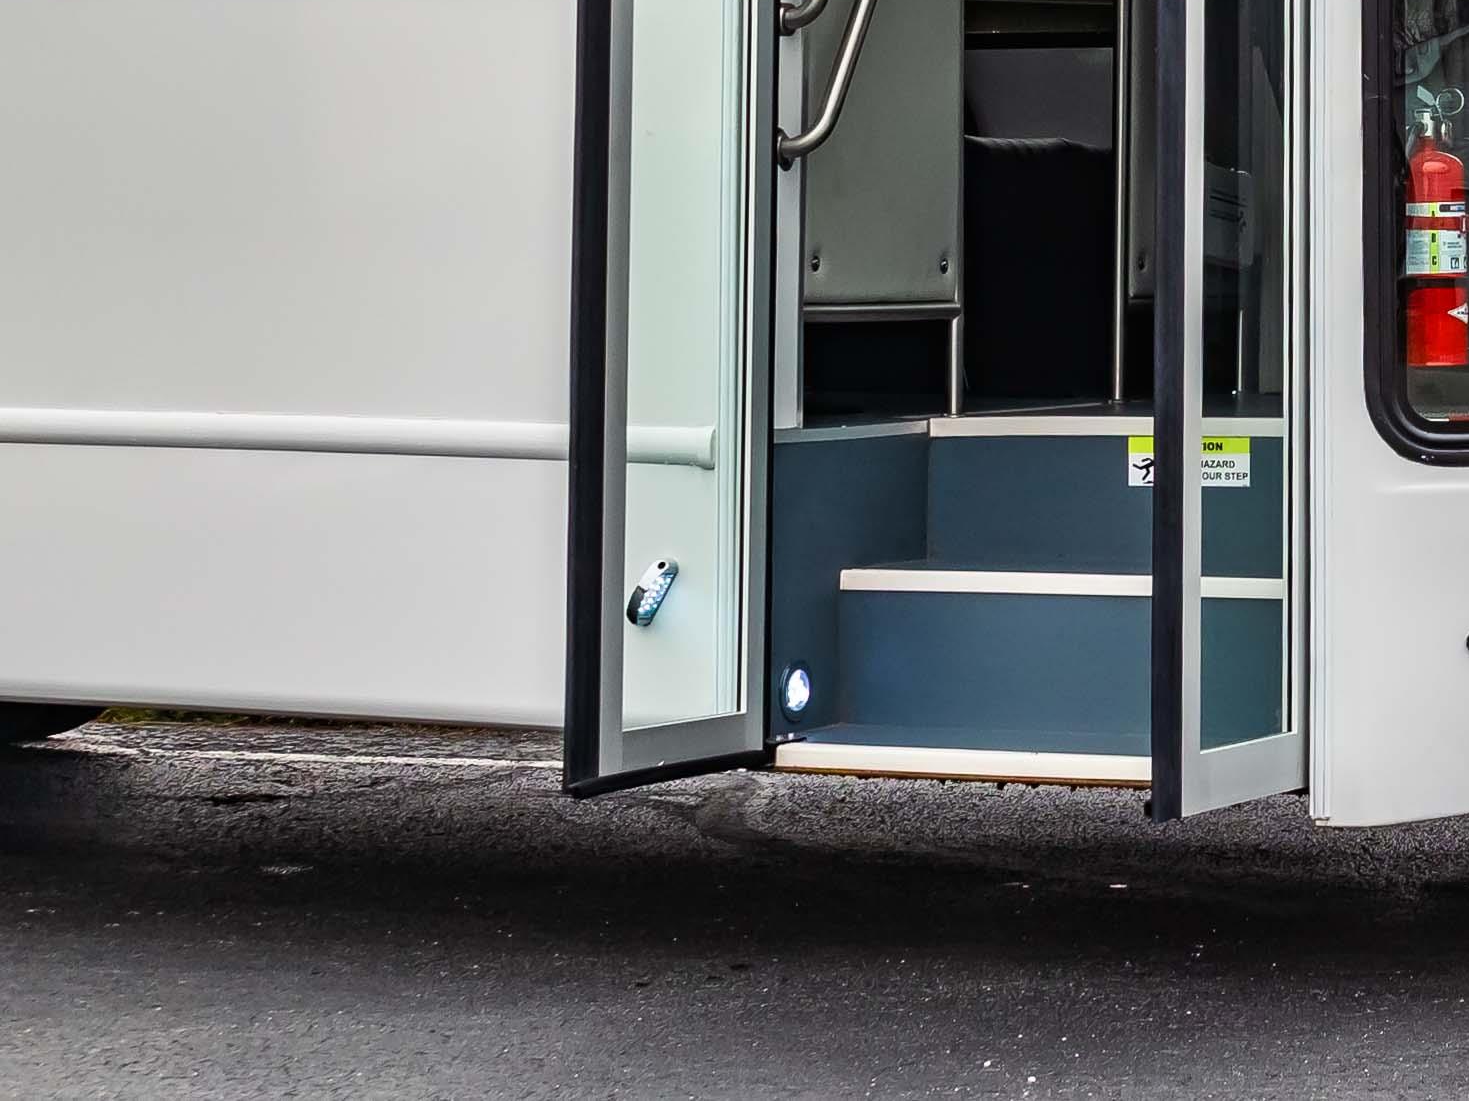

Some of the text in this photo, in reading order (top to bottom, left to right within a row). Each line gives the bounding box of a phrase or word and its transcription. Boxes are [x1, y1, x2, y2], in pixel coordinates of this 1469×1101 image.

[1202, 442, 1223, 451] ION
[1202, 472, 1248, 481] OUR STEP
